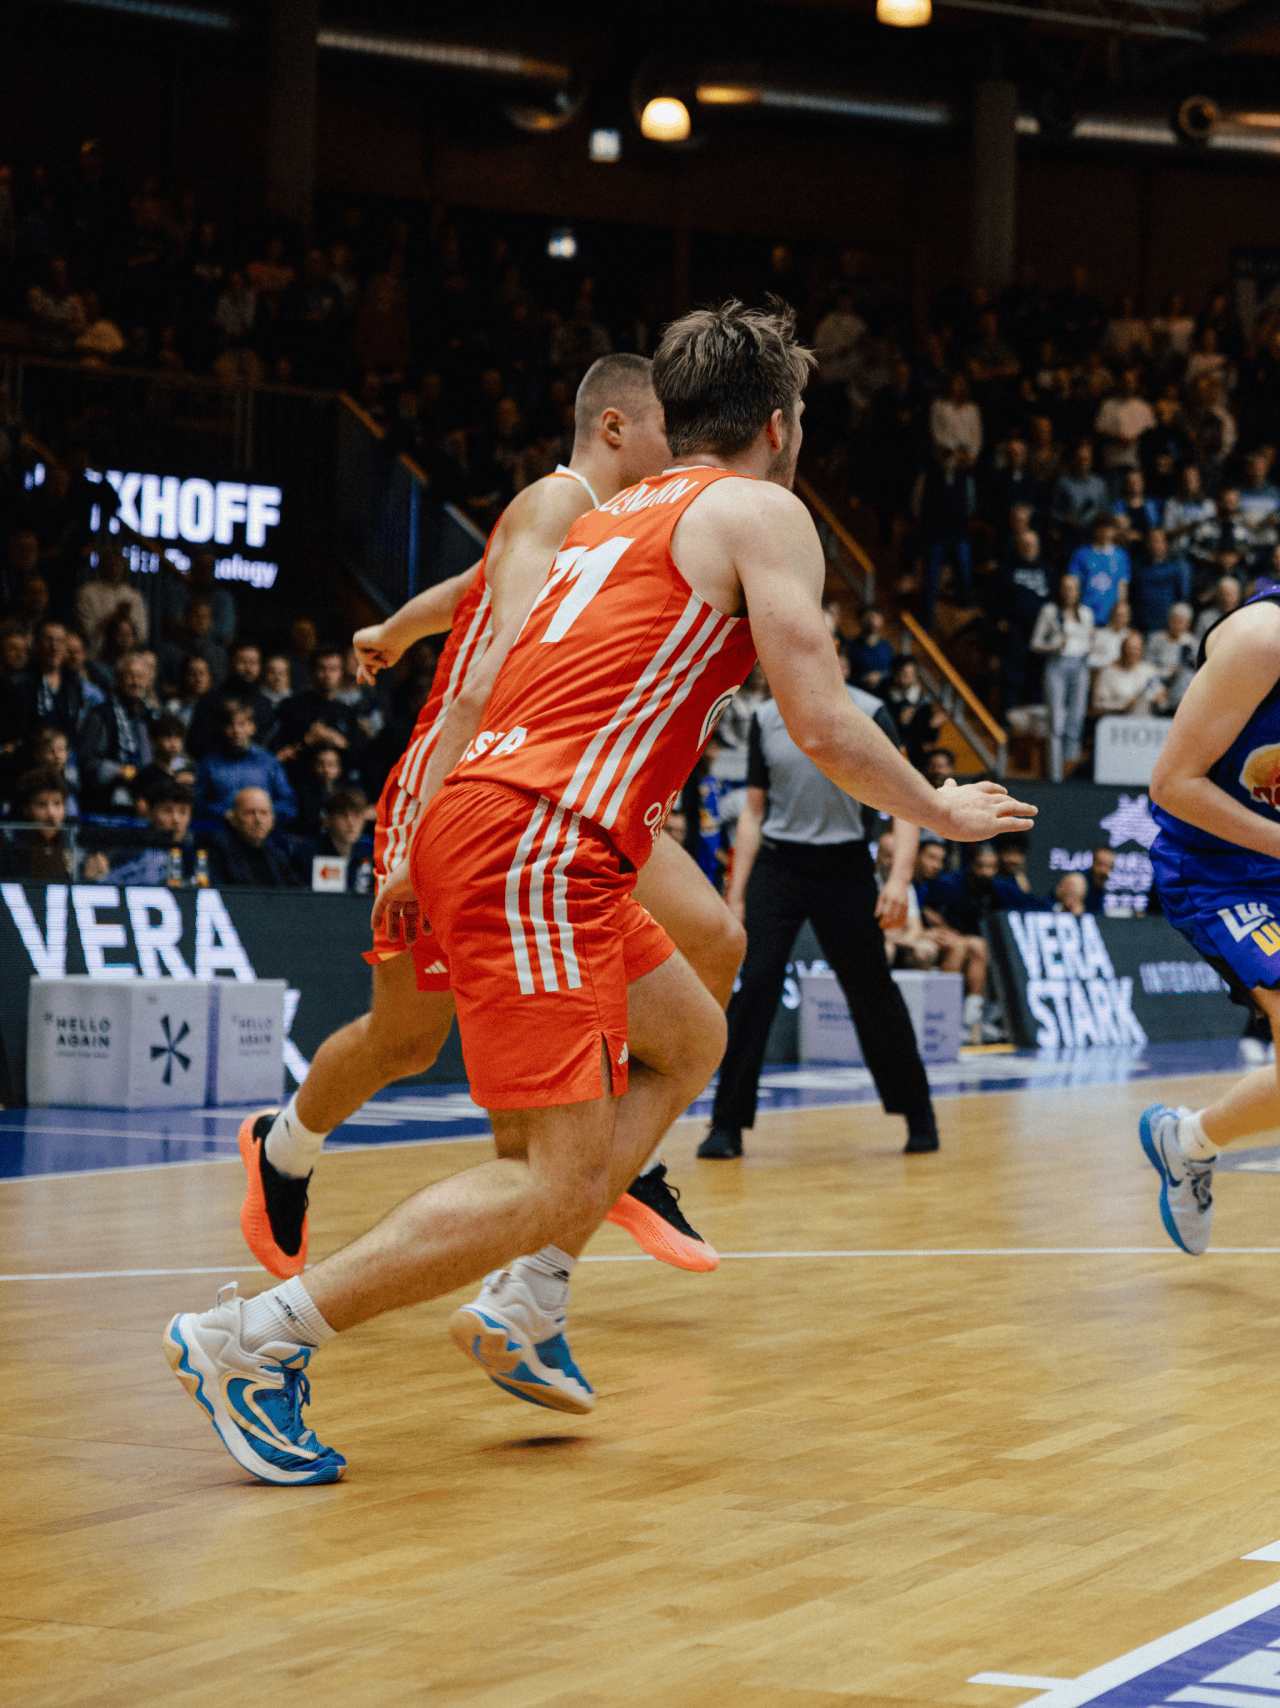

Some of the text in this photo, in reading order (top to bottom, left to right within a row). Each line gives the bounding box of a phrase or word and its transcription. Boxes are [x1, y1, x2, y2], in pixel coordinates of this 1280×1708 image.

[0, 882, 257, 984] VERA
[1006, 910, 1116, 981] VERA
[56, 1016, 111, 1033] HELLO
[56, 1034, 111, 1048] AGAIN
[1026, 976, 1149, 1049] STARK
